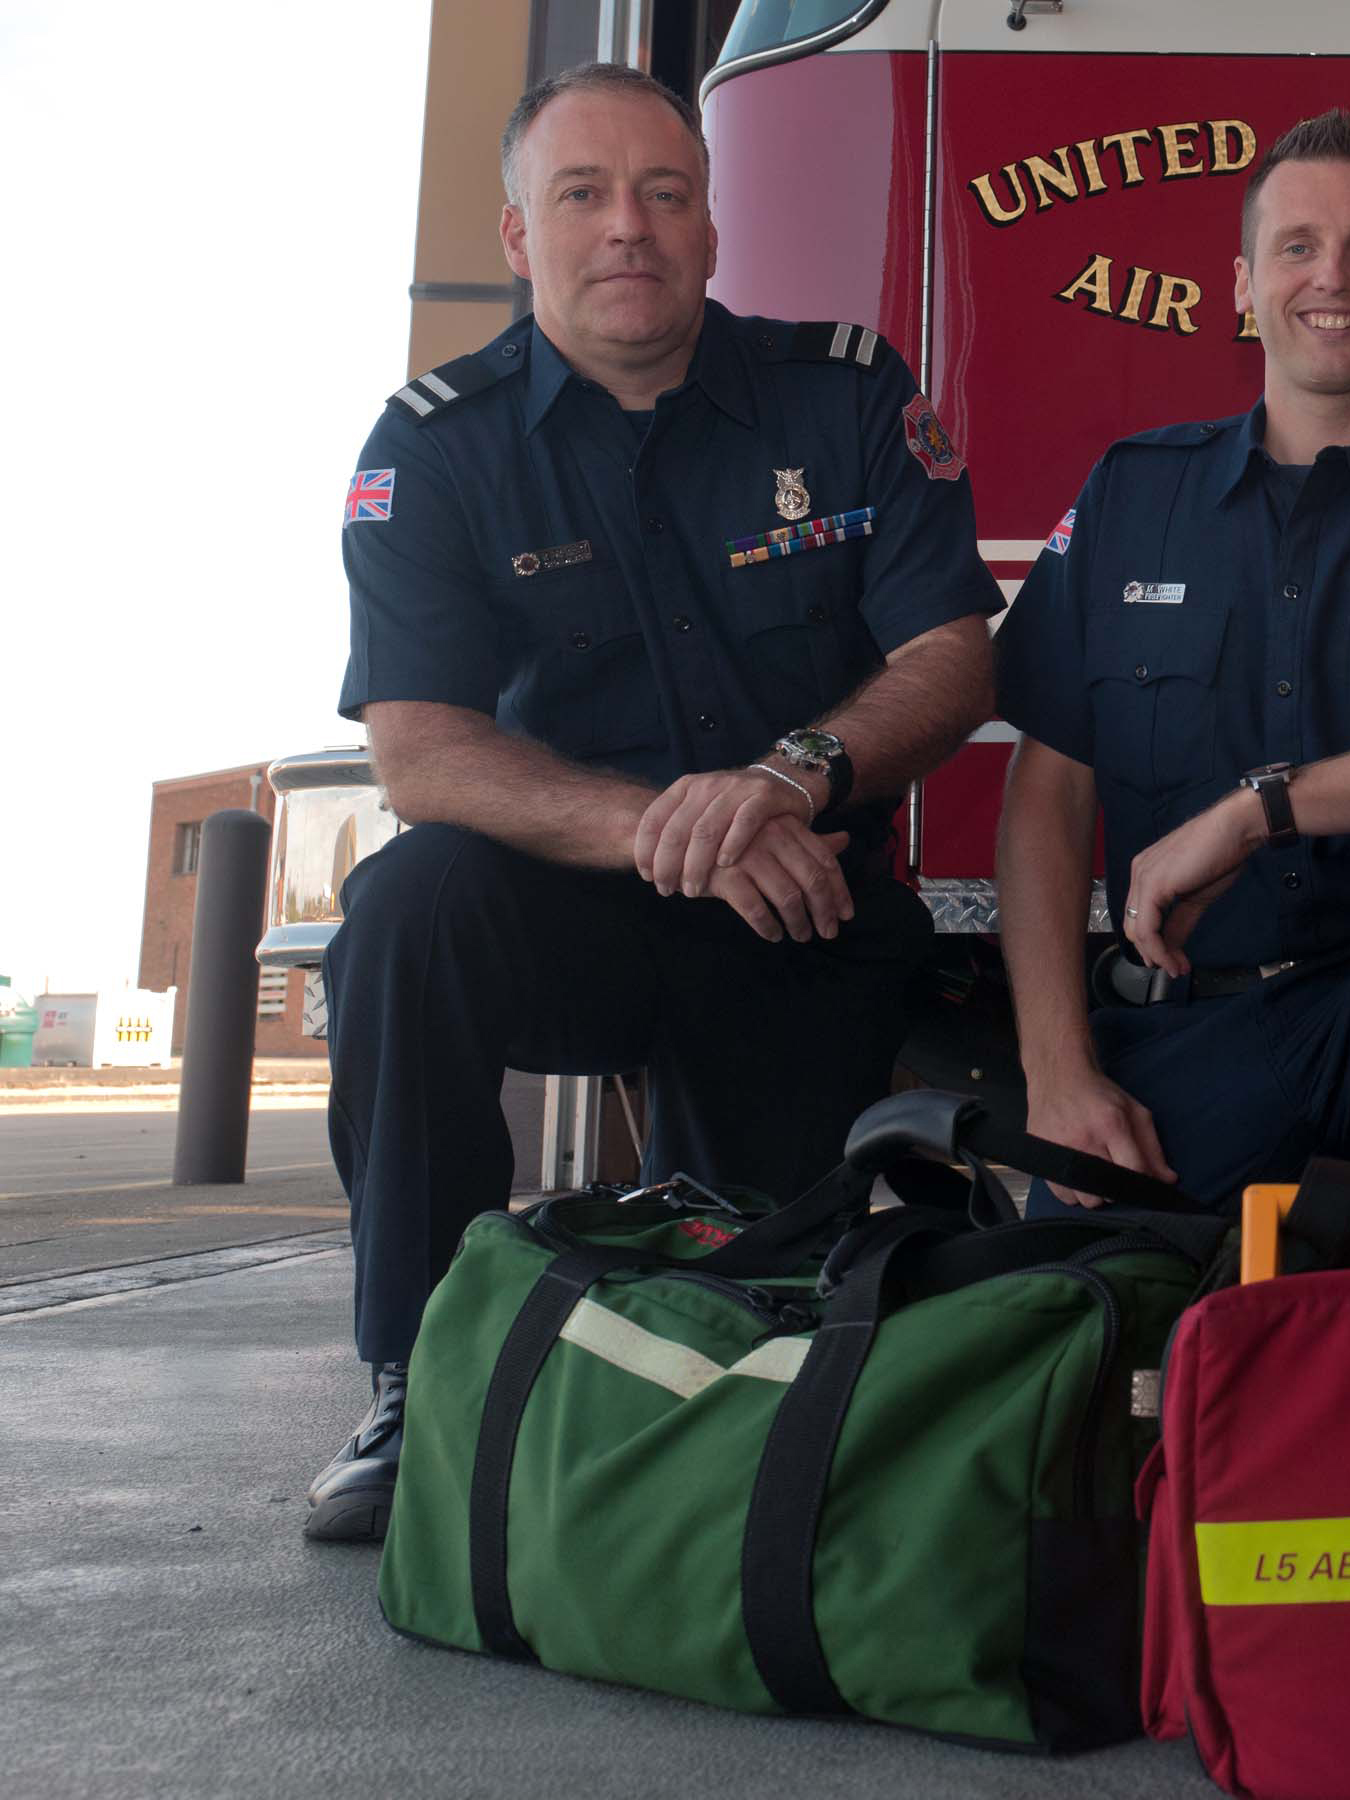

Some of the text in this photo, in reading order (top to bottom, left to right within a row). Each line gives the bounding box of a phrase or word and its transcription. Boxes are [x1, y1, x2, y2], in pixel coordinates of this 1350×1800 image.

[967, 118, 1257, 228] UNITED
[1053, 253, 1202, 336] AIR
[1254, 1552, 1299, 1582] L5
